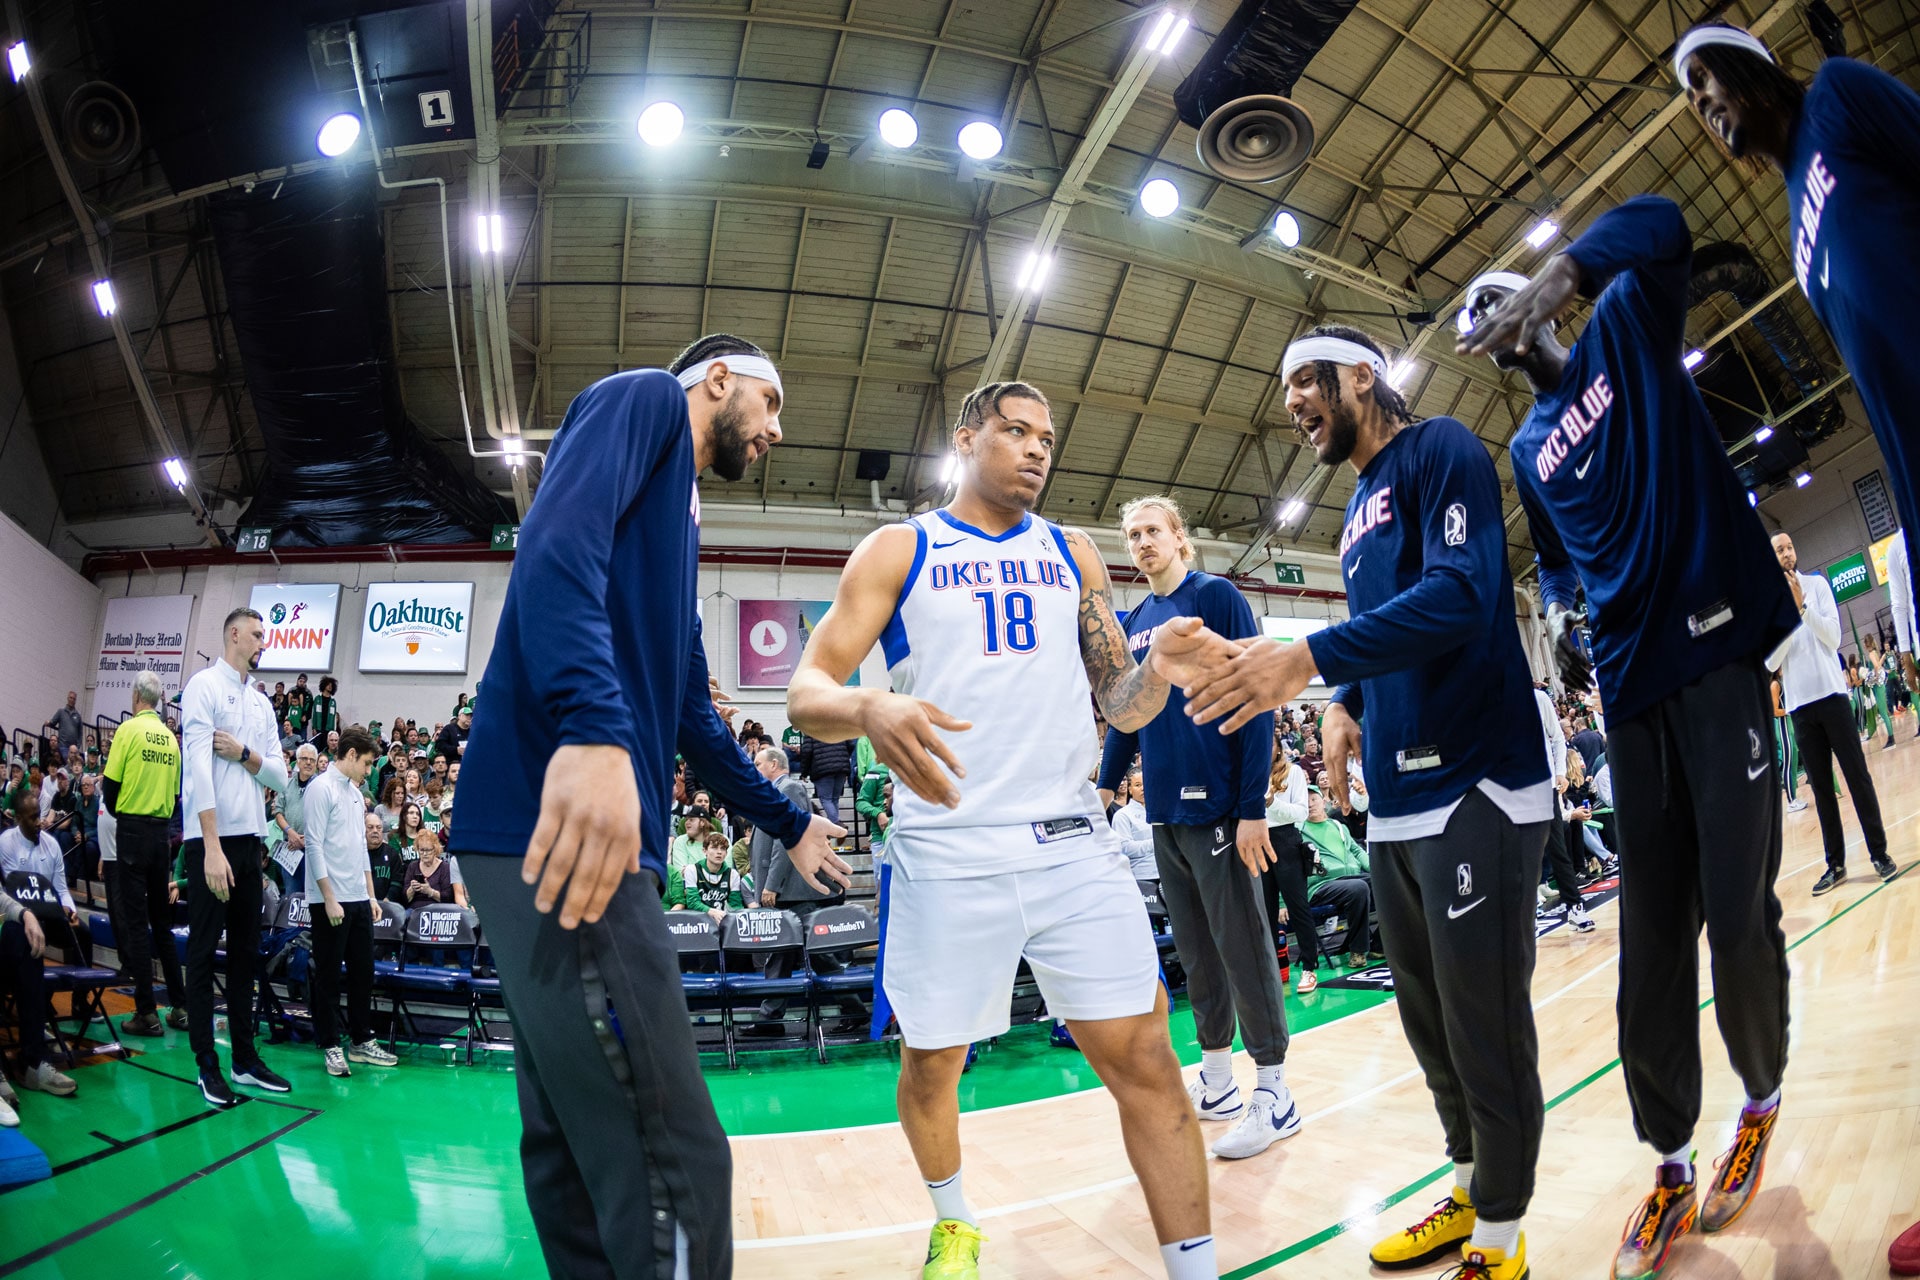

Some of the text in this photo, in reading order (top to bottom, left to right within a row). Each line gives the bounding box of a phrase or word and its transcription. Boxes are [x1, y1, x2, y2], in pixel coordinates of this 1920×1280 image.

[428, 97, 446, 120] 1
[1800, 151, 1838, 247] BLUE
[1536, 372, 1614, 482] OKC BLUE
[1351, 486, 1392, 544] BLUE
[254, 535, 267, 549] 18
[930, 559, 1072, 592] OKC BLUE
[1292, 571, 1299, 583] 1
[1836, 574, 1866, 592] ACADEMY
[369, 598, 464, 633] Oakhurst
[971, 588, 1040, 656] 18
[104, 632, 182, 649] Portland Press Herald
[263, 628, 329, 649] UNKIN'
[1128, 629, 1151, 652] OKC
[99, 657, 180, 675] Maine Sunday Telegram
[145, 731, 170, 746] GUEST
[28, 875, 39, 887] 12
[431, 920, 459, 935] FINALS
[667, 922, 709, 934] ouTubeTV
[751, 918, 781, 935] FINALS
